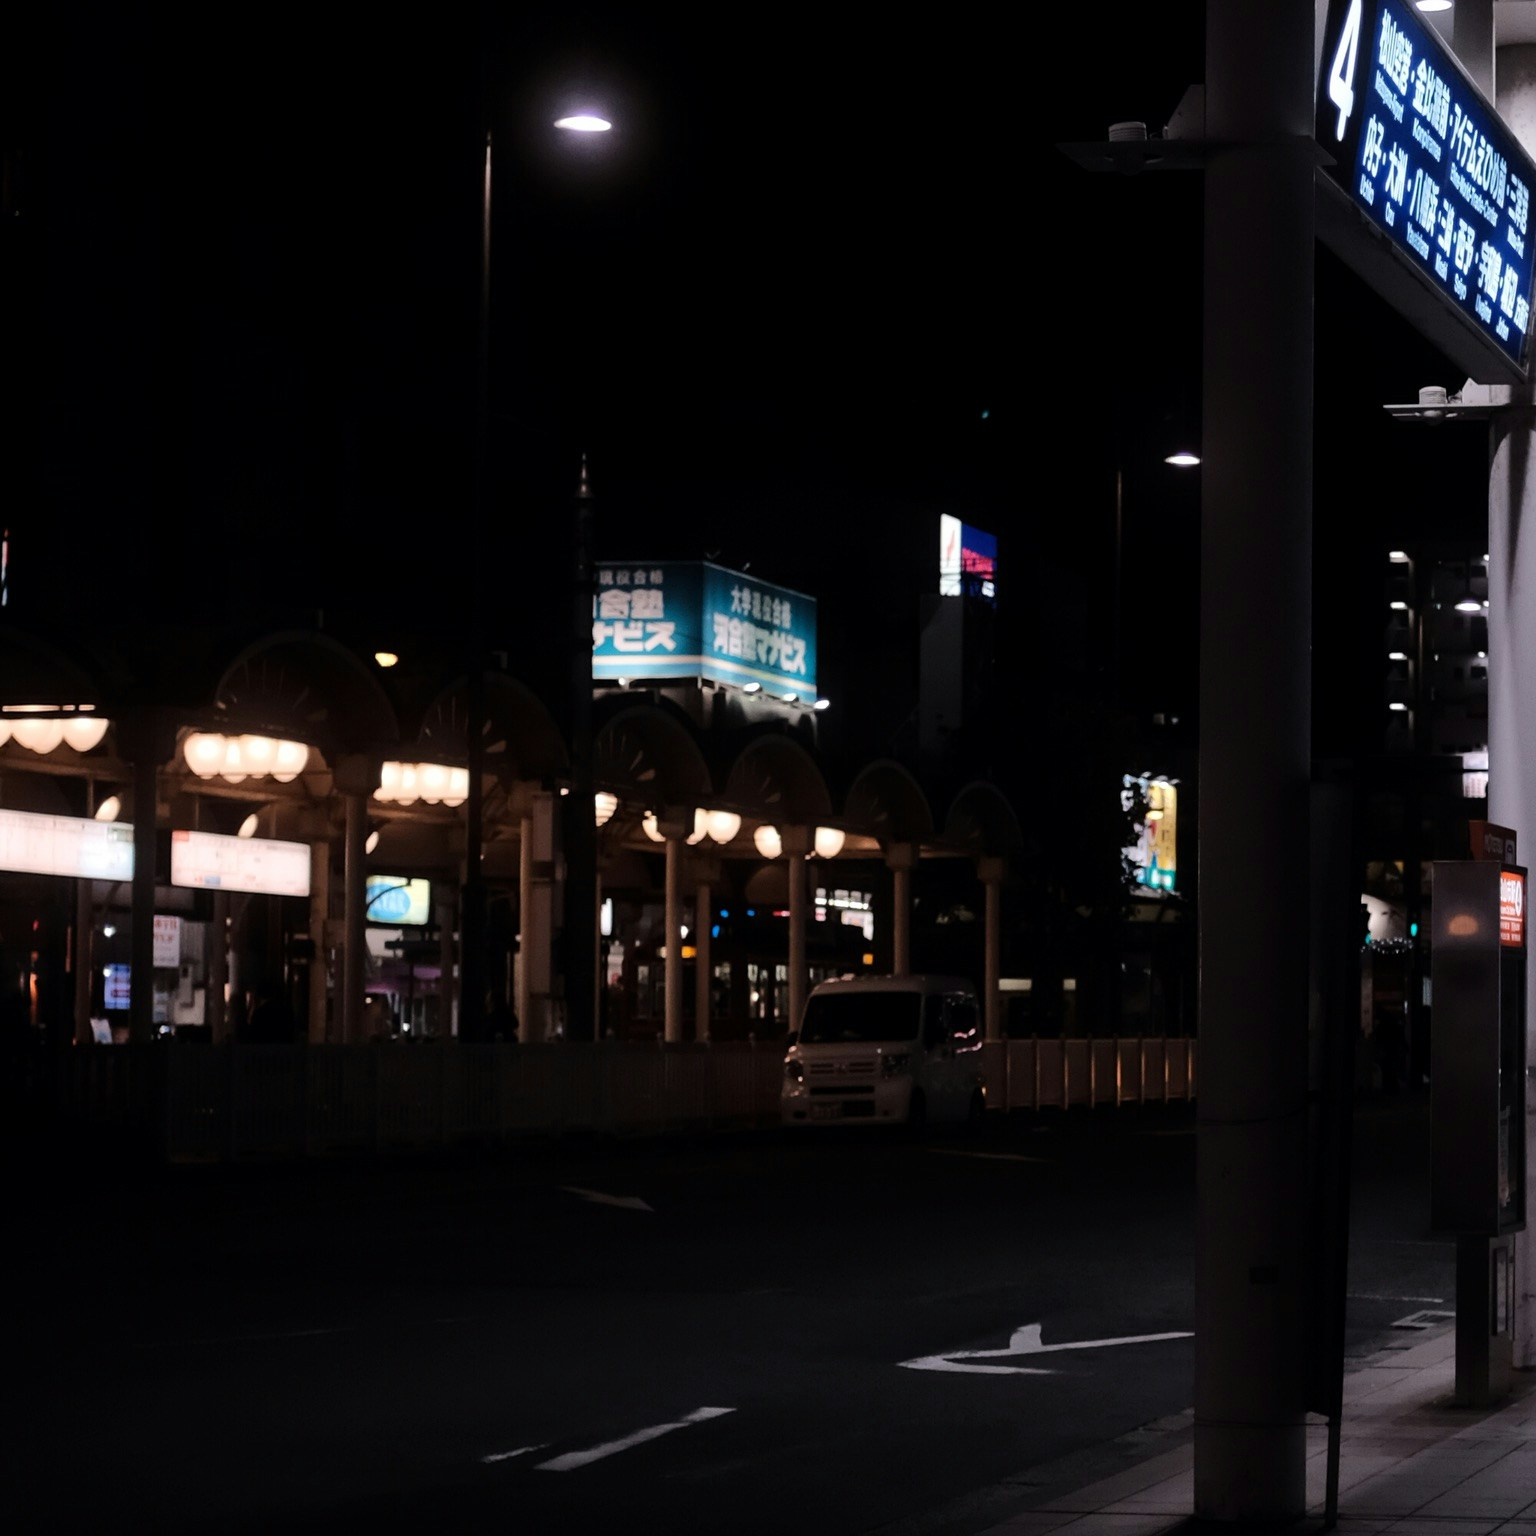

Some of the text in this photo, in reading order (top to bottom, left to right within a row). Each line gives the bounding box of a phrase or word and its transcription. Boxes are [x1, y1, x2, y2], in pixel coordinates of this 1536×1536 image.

[594, 569, 664, 585] 現役合格
[592, 589, 665, 619] 合塾
[713, 611, 807, 676] 河合塾マナビス
